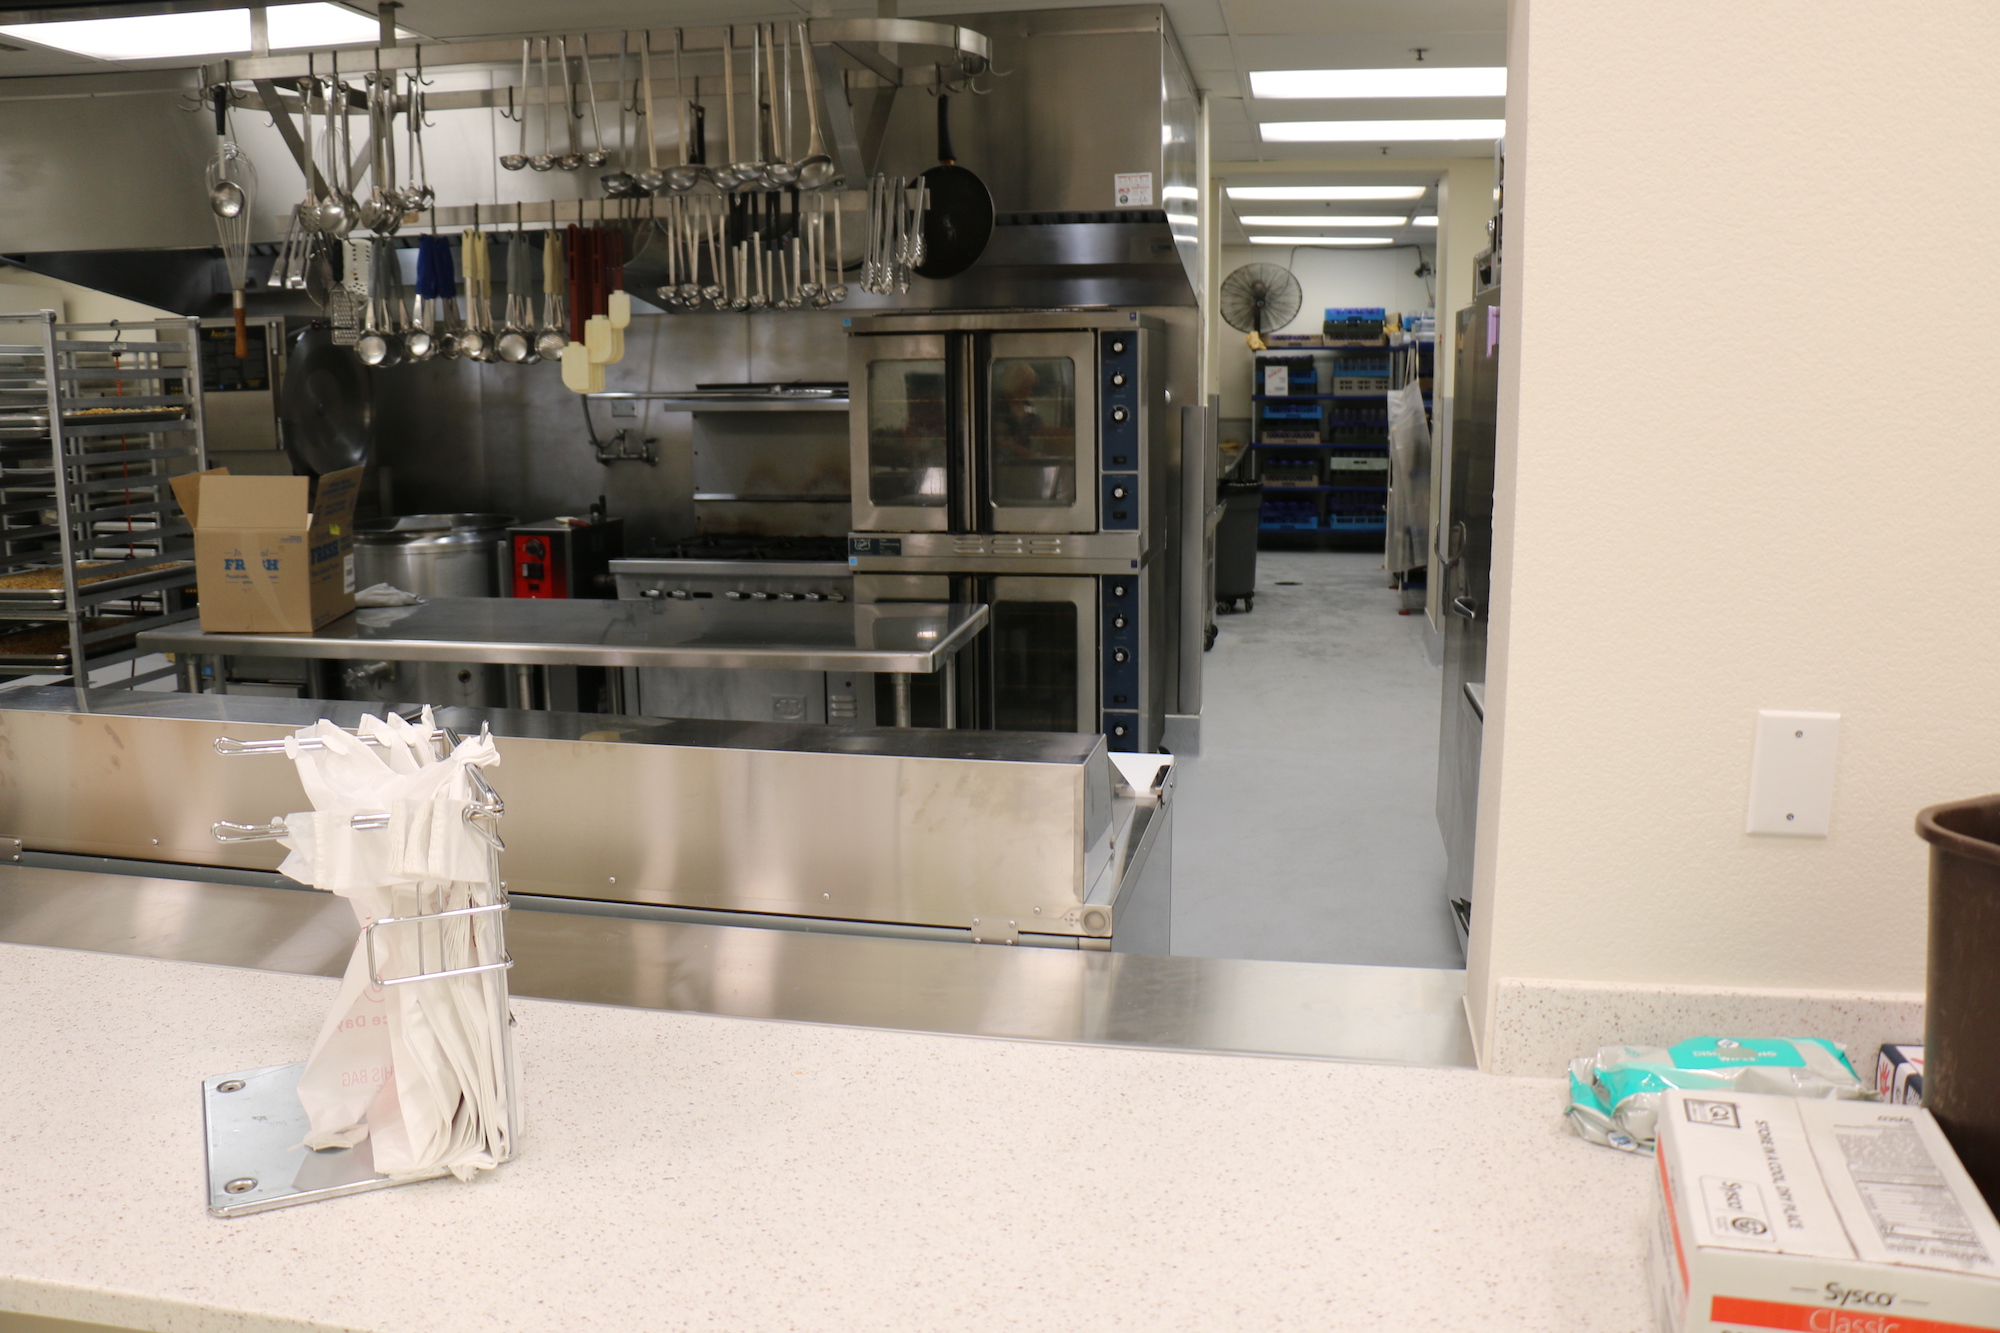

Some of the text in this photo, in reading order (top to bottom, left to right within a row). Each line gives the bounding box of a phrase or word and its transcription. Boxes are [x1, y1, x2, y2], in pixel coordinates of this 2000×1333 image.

[224, 558, 279, 571] FRH
[1824, 1282, 1897, 1307] Sysco
[1809, 1308, 1901, 1333] Classic
